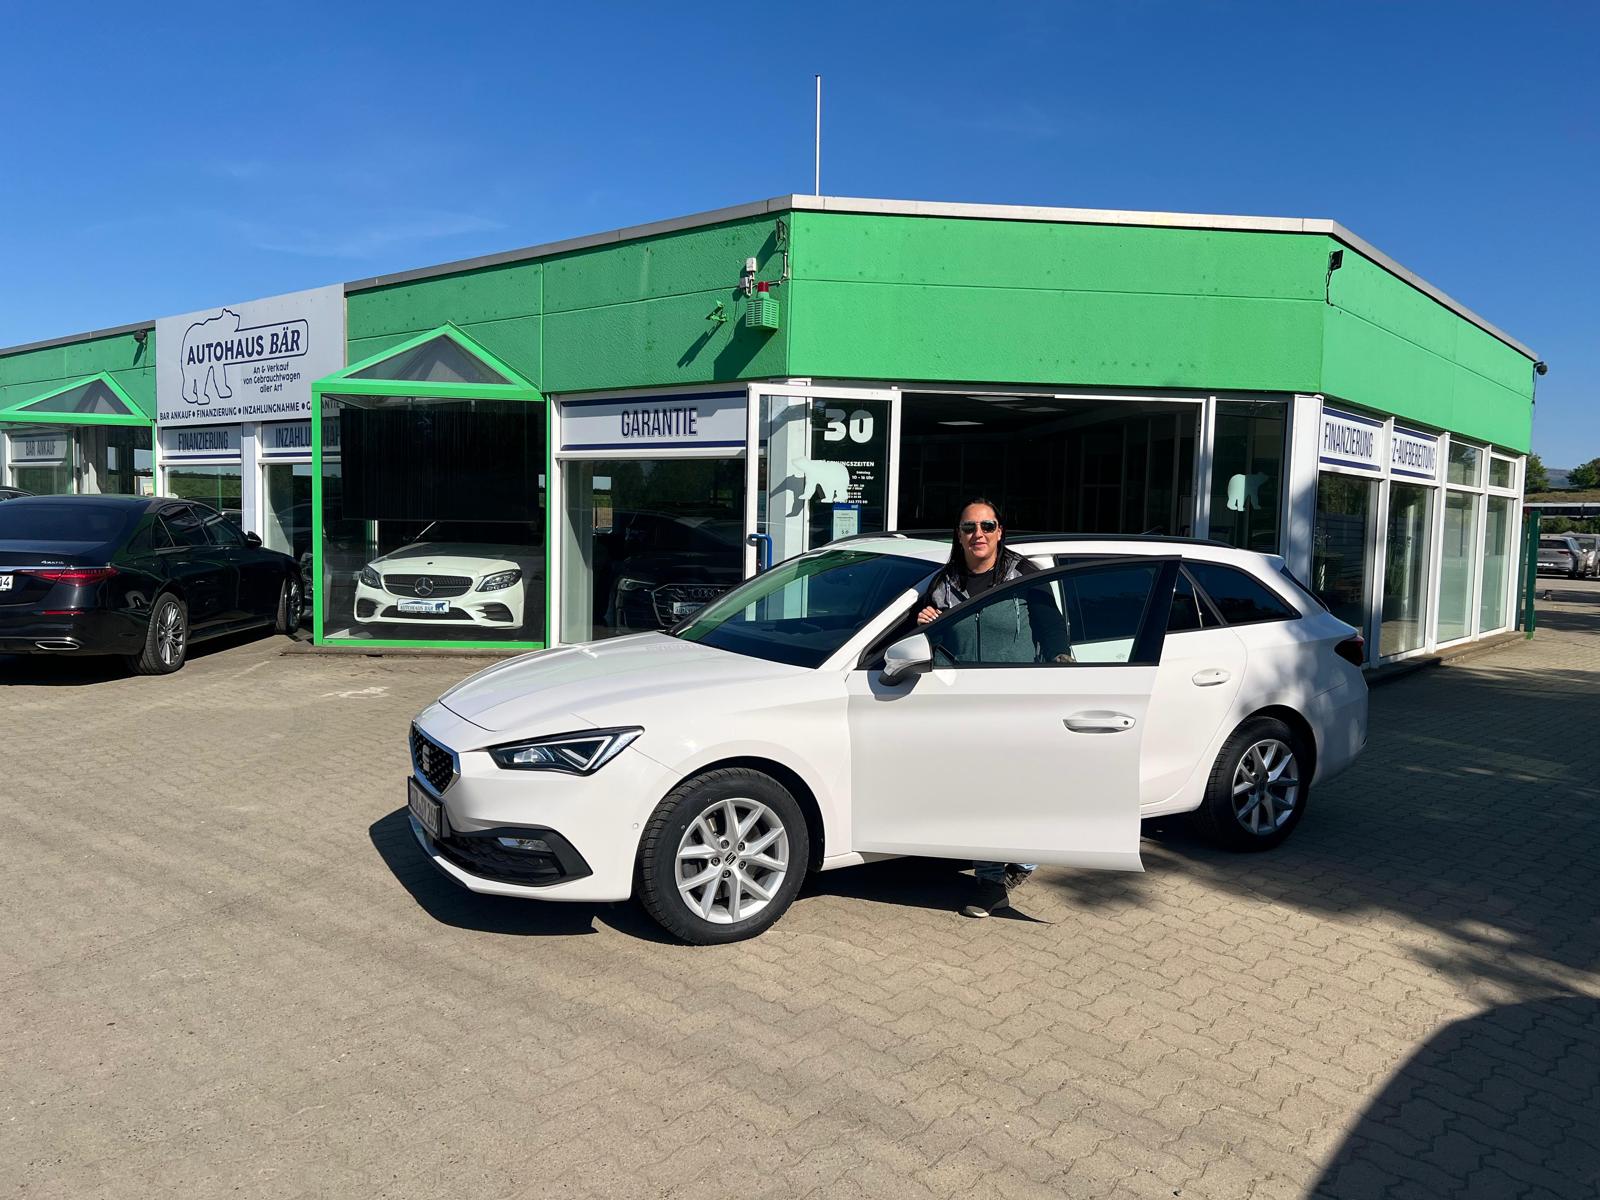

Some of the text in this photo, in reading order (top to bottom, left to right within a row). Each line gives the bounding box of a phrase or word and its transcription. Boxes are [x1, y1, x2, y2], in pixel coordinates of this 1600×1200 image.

[187, 326, 301, 366] AUTOHAUS BÄR
[253, 361, 290, 374] An & Verkauf
[243, 372, 301, 384] von Gebrauchtwagen
[260, 383, 283, 393] aller Art
[160, 411, 170, 420] BAR
[171, 410, 192, 419] ANKAUF
[196, 406, 237, 418] FINANZIERUNG
[242, 402, 300, 415] INZAHLUNGNAHME
[621, 407, 698, 437] GARANTIE
[824, 409, 874, 443] 30
[178, 431, 229, 450] FINANZIERUNG
[1323, 422, 1374, 458] FINANZIERUNG
